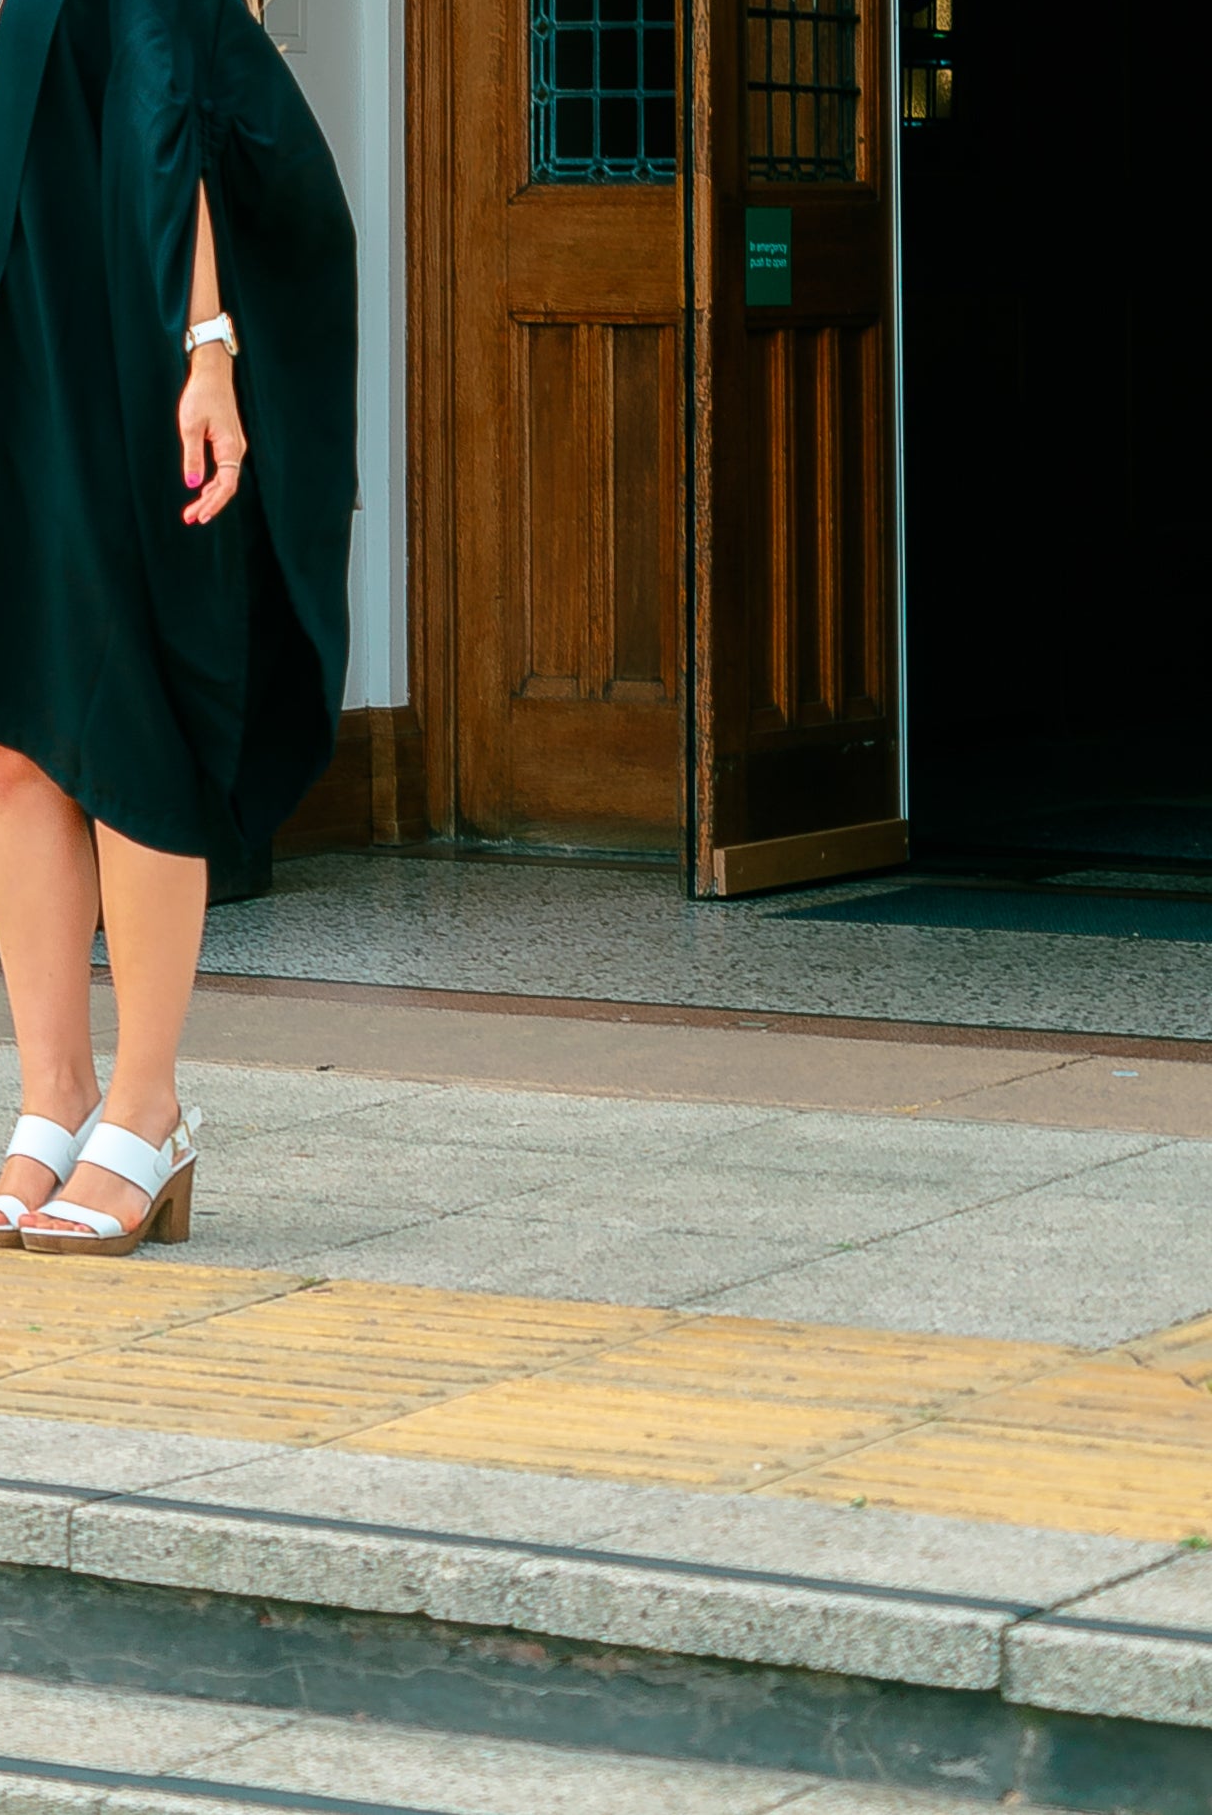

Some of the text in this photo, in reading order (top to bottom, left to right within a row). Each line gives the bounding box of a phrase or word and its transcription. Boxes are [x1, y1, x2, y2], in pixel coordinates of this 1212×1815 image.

[756, 242, 787, 255] emergency
[750, 257, 764, 269] push
[772, 258, 787, 269] open
